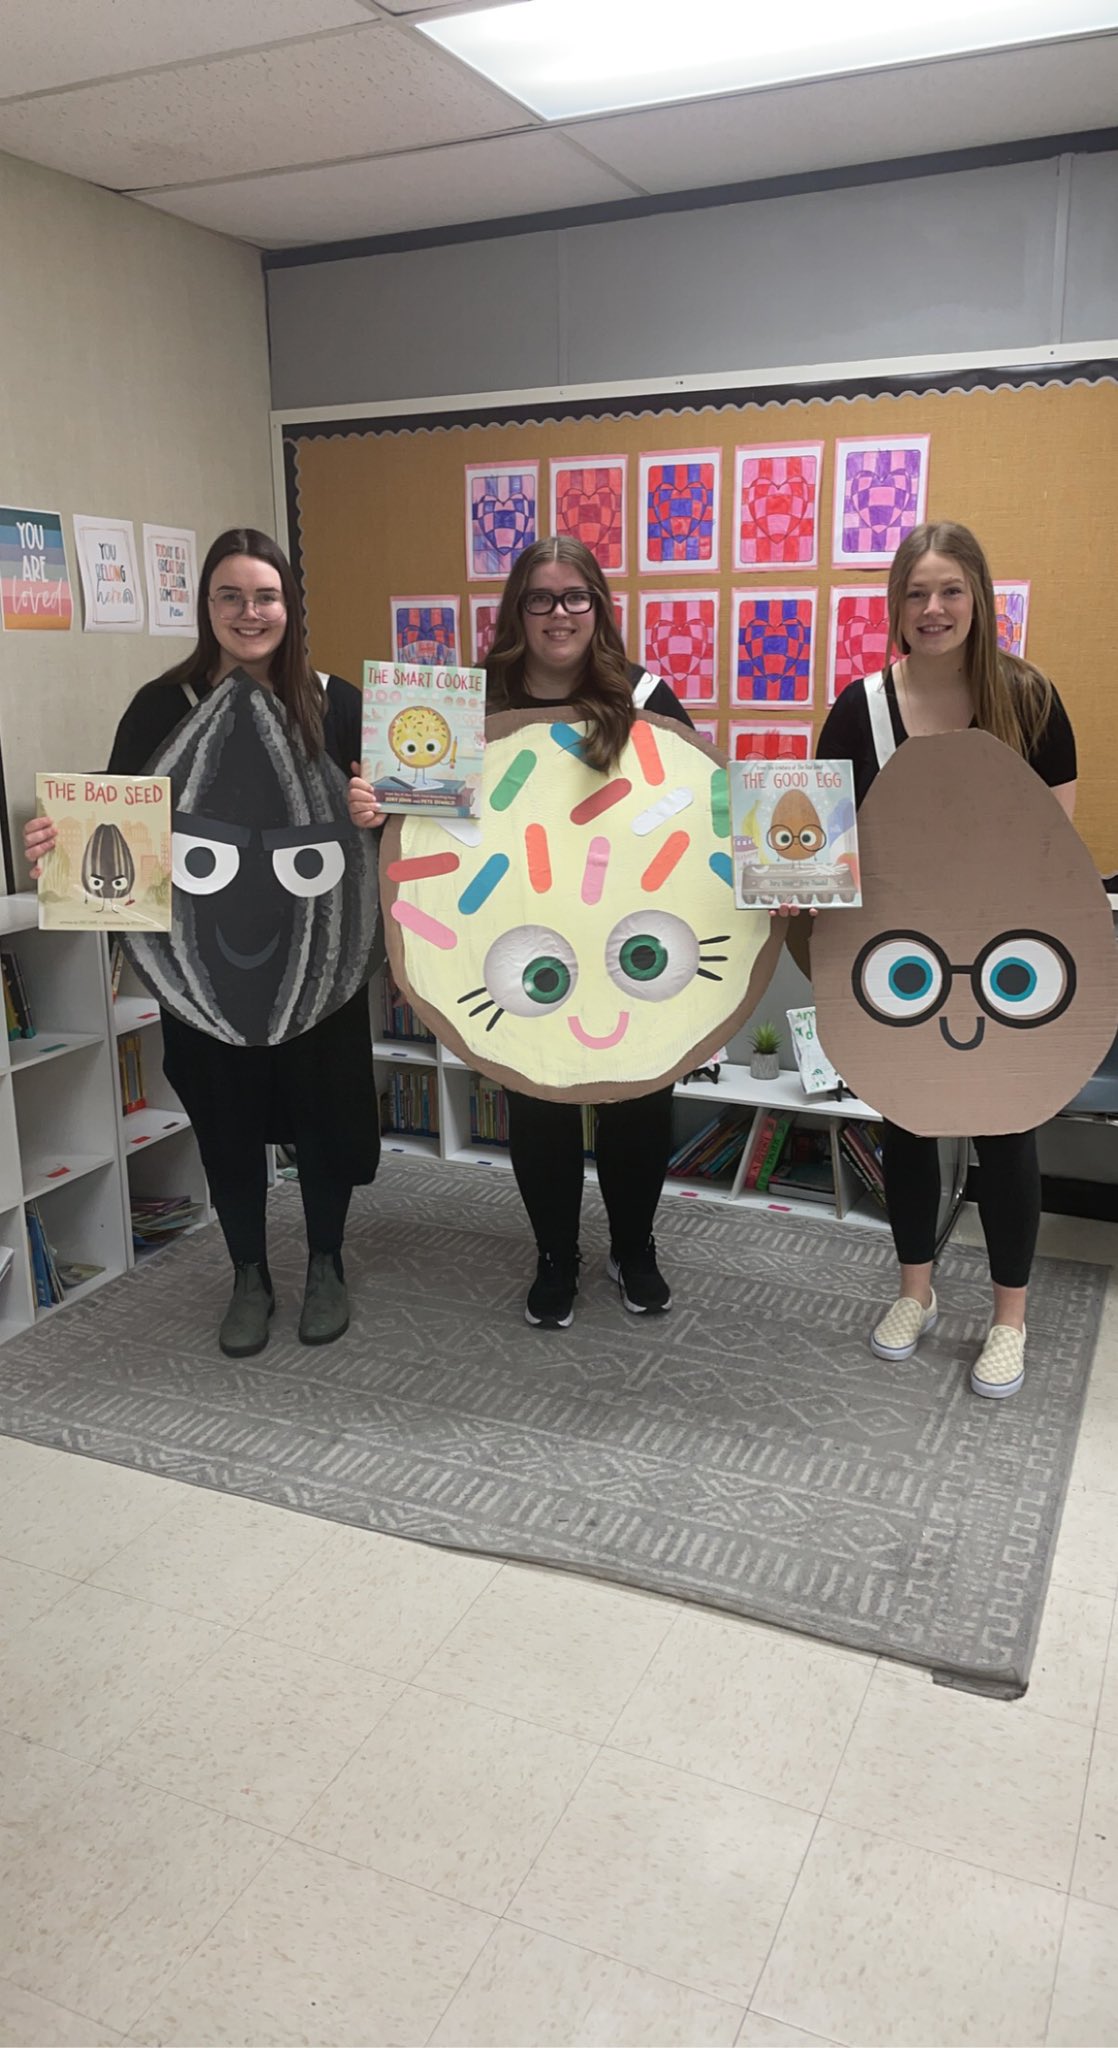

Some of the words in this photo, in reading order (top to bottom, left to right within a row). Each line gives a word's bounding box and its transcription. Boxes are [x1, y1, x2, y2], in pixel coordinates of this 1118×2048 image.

[16, 521, 44, 550] YOU
[98, 542, 116, 561] YOU
[23, 555, 48, 583] ARE
[95, 563, 126, 583] BELONG
[12, 575, 62, 617] loved
[368, 667, 389, 684] THE
[393, 668, 432, 689] SMART
[436, 671, 483, 692] COOKIE
[44, 780, 76, 802] THE
[84, 781, 118, 804] BAD
[124, 784, 164, 806] SEED
[742, 771, 766, 790] THE
[773, 771, 809, 789] GOOD
[815, 771, 842, 789] EGG
